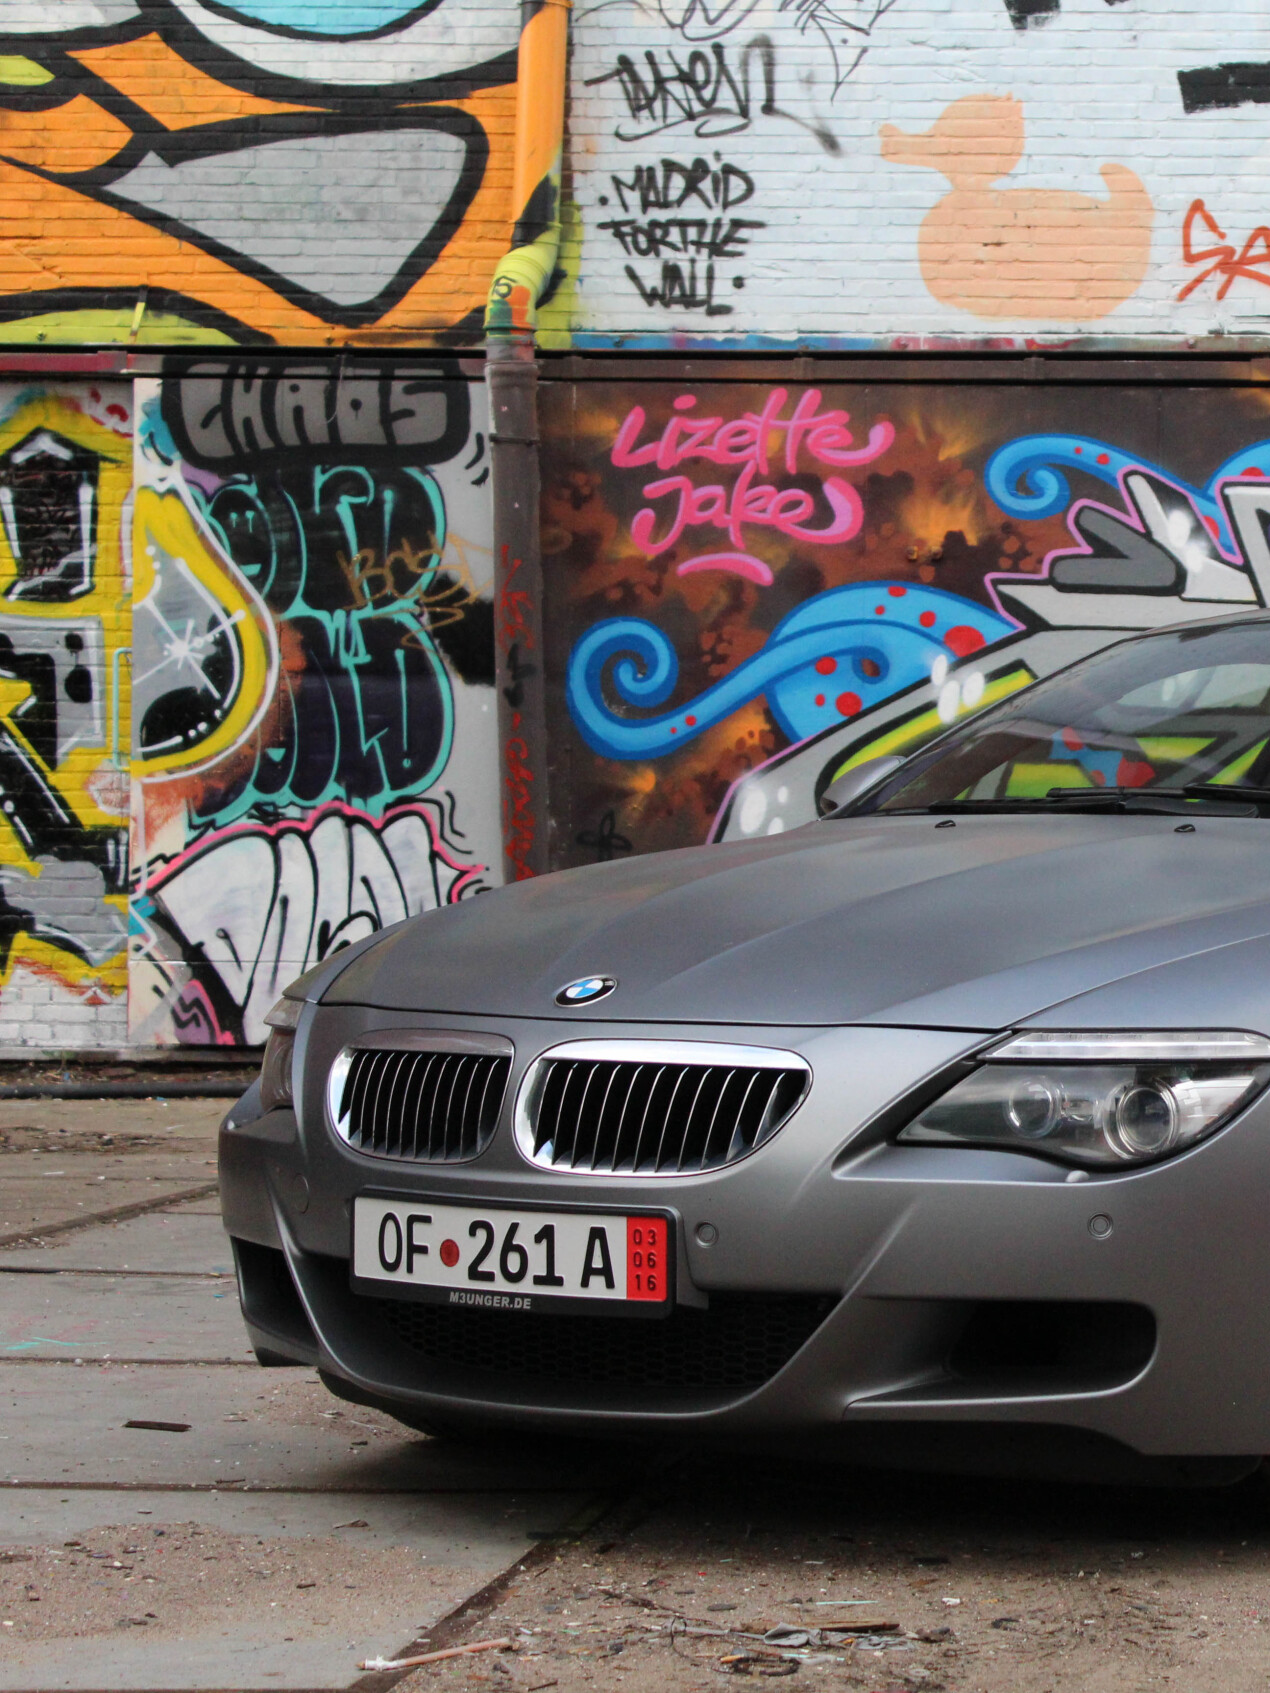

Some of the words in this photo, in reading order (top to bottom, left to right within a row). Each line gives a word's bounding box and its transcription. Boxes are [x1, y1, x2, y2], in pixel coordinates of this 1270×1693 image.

[172, 358, 452, 462] CHAOS
[611, 388, 895, 475] Lizette
[379, 1212, 432, 1274] OF
[468, 1220, 564, 1287] 261
[580, 1226, 616, 1289] A
[633, 1228, 657, 1246] 03
[633, 1251, 657, 1269] 06
[634, 1274, 657, 1291] 16
